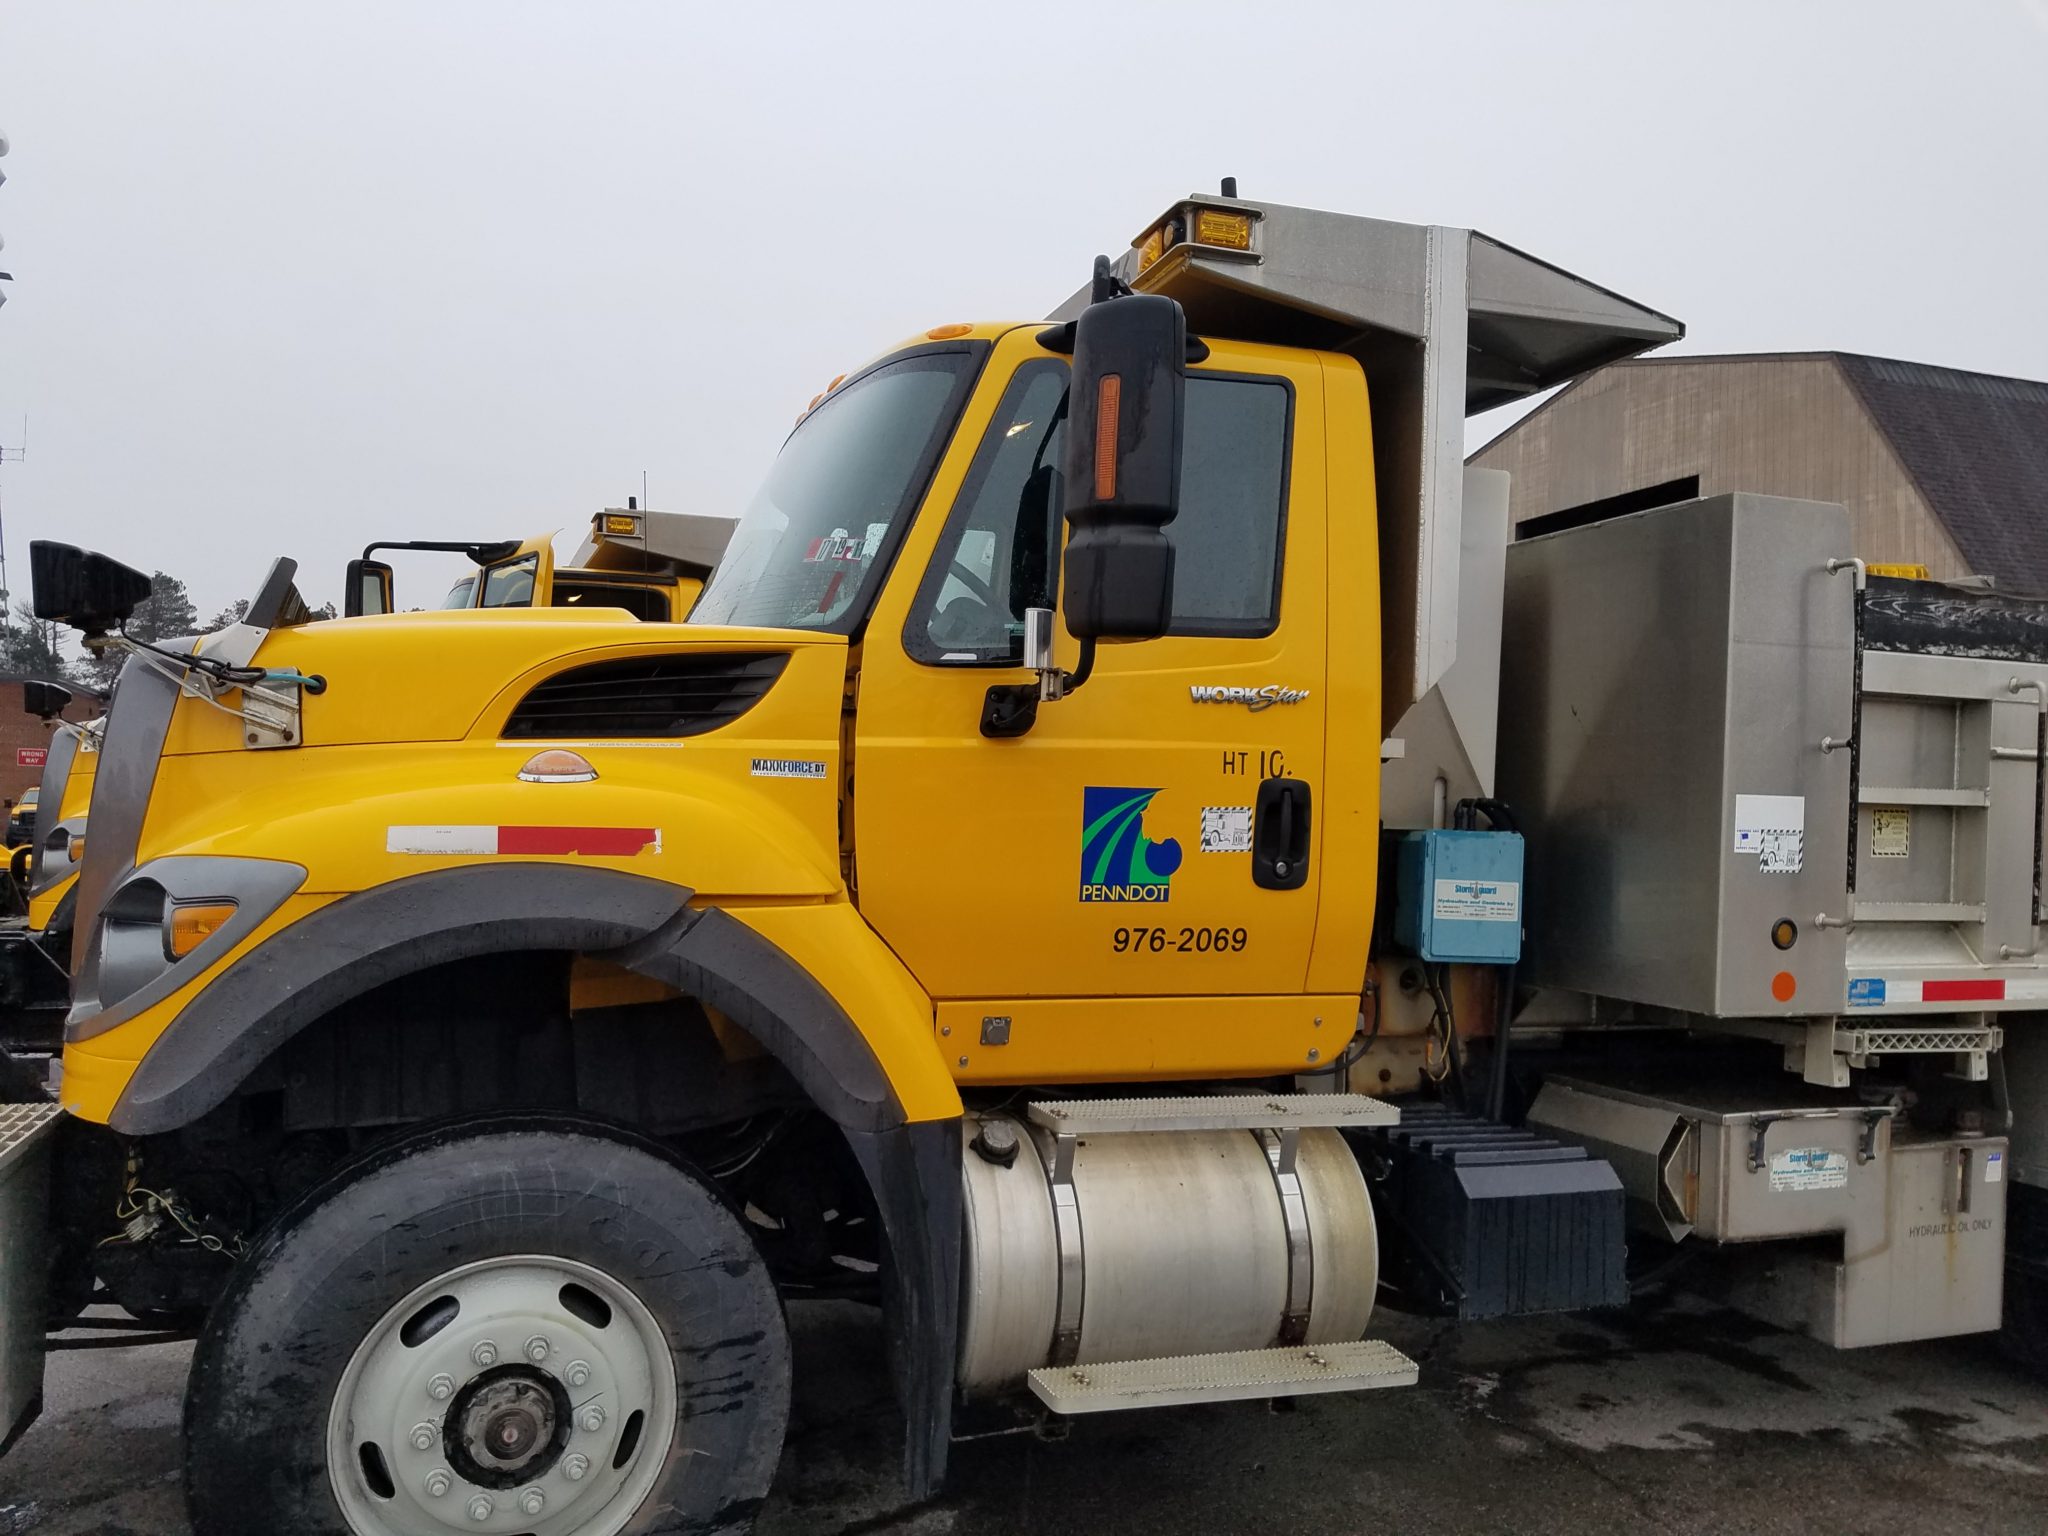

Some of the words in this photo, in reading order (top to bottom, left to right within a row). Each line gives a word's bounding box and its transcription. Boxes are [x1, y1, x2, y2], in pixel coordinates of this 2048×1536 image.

[752, 759, 813, 773] MAXXFORCE
[815, 764, 825, 773] DT
[1223, 751, 1249, 775] HT
[1082, 885, 1168, 901] PENNDOT
[1113, 928, 1247, 952] 976-2069
[1909, 1223, 1957, 1238] HYDRAULIC
[1958, 1221, 1969, 1233] OIL
[1972, 1219, 1993, 1231] ONLY
